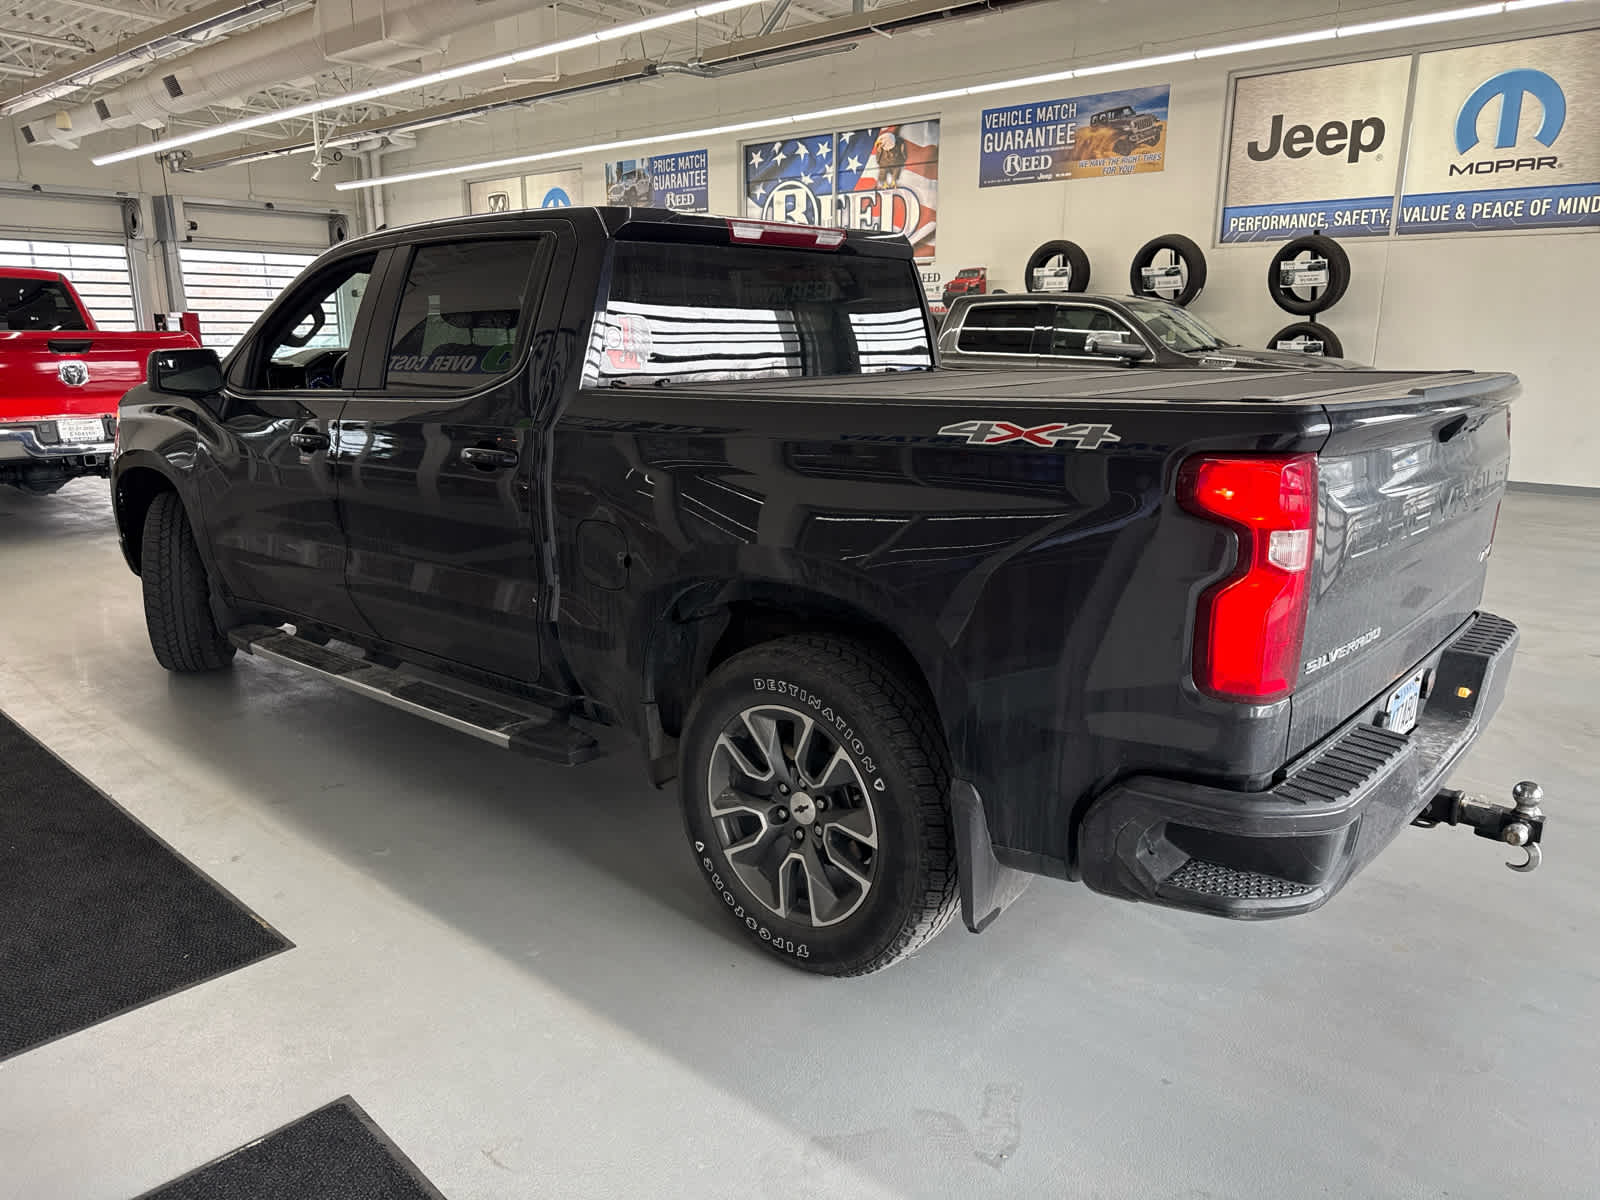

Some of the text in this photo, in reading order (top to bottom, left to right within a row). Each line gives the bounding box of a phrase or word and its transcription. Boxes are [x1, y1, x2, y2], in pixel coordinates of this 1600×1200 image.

[985, 103, 1077, 129] VEHICLE MATCH
[983, 122, 1077, 153] GUARANTEE
[1247, 114, 1386, 164] Jeep
[653, 153, 706, 174] PRICE MATCH
[1448, 156, 1558, 177] MOPAR
[653, 170, 707, 191] GUARANTEE
[1230, 208, 1391, 232] PERFORMANCE, SAFETY,
[1403, 195, 1600, 222] VALUE & PEACE OF MIND
[1304, 626, 1382, 675] SILVERADO
[752, 677, 876, 774] DESTINATION
